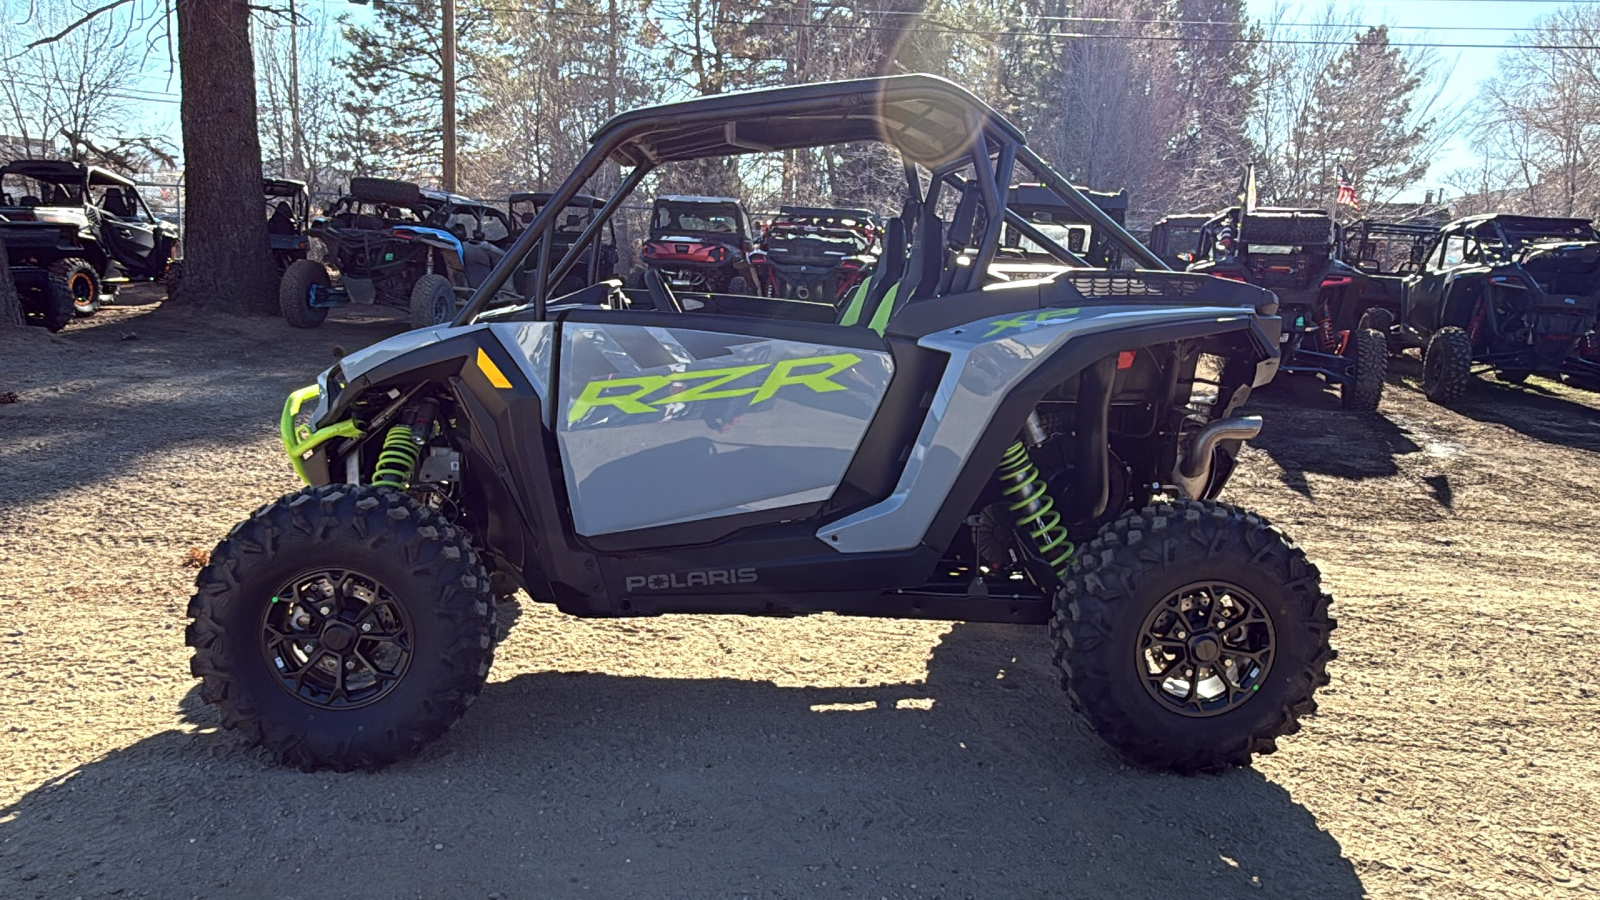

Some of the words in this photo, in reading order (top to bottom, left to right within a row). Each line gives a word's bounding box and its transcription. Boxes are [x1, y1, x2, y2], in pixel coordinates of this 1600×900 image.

[982, 307, 1080, 338] XP
[568, 354, 861, 422] RZR
[625, 567, 758, 592] POLARIS
